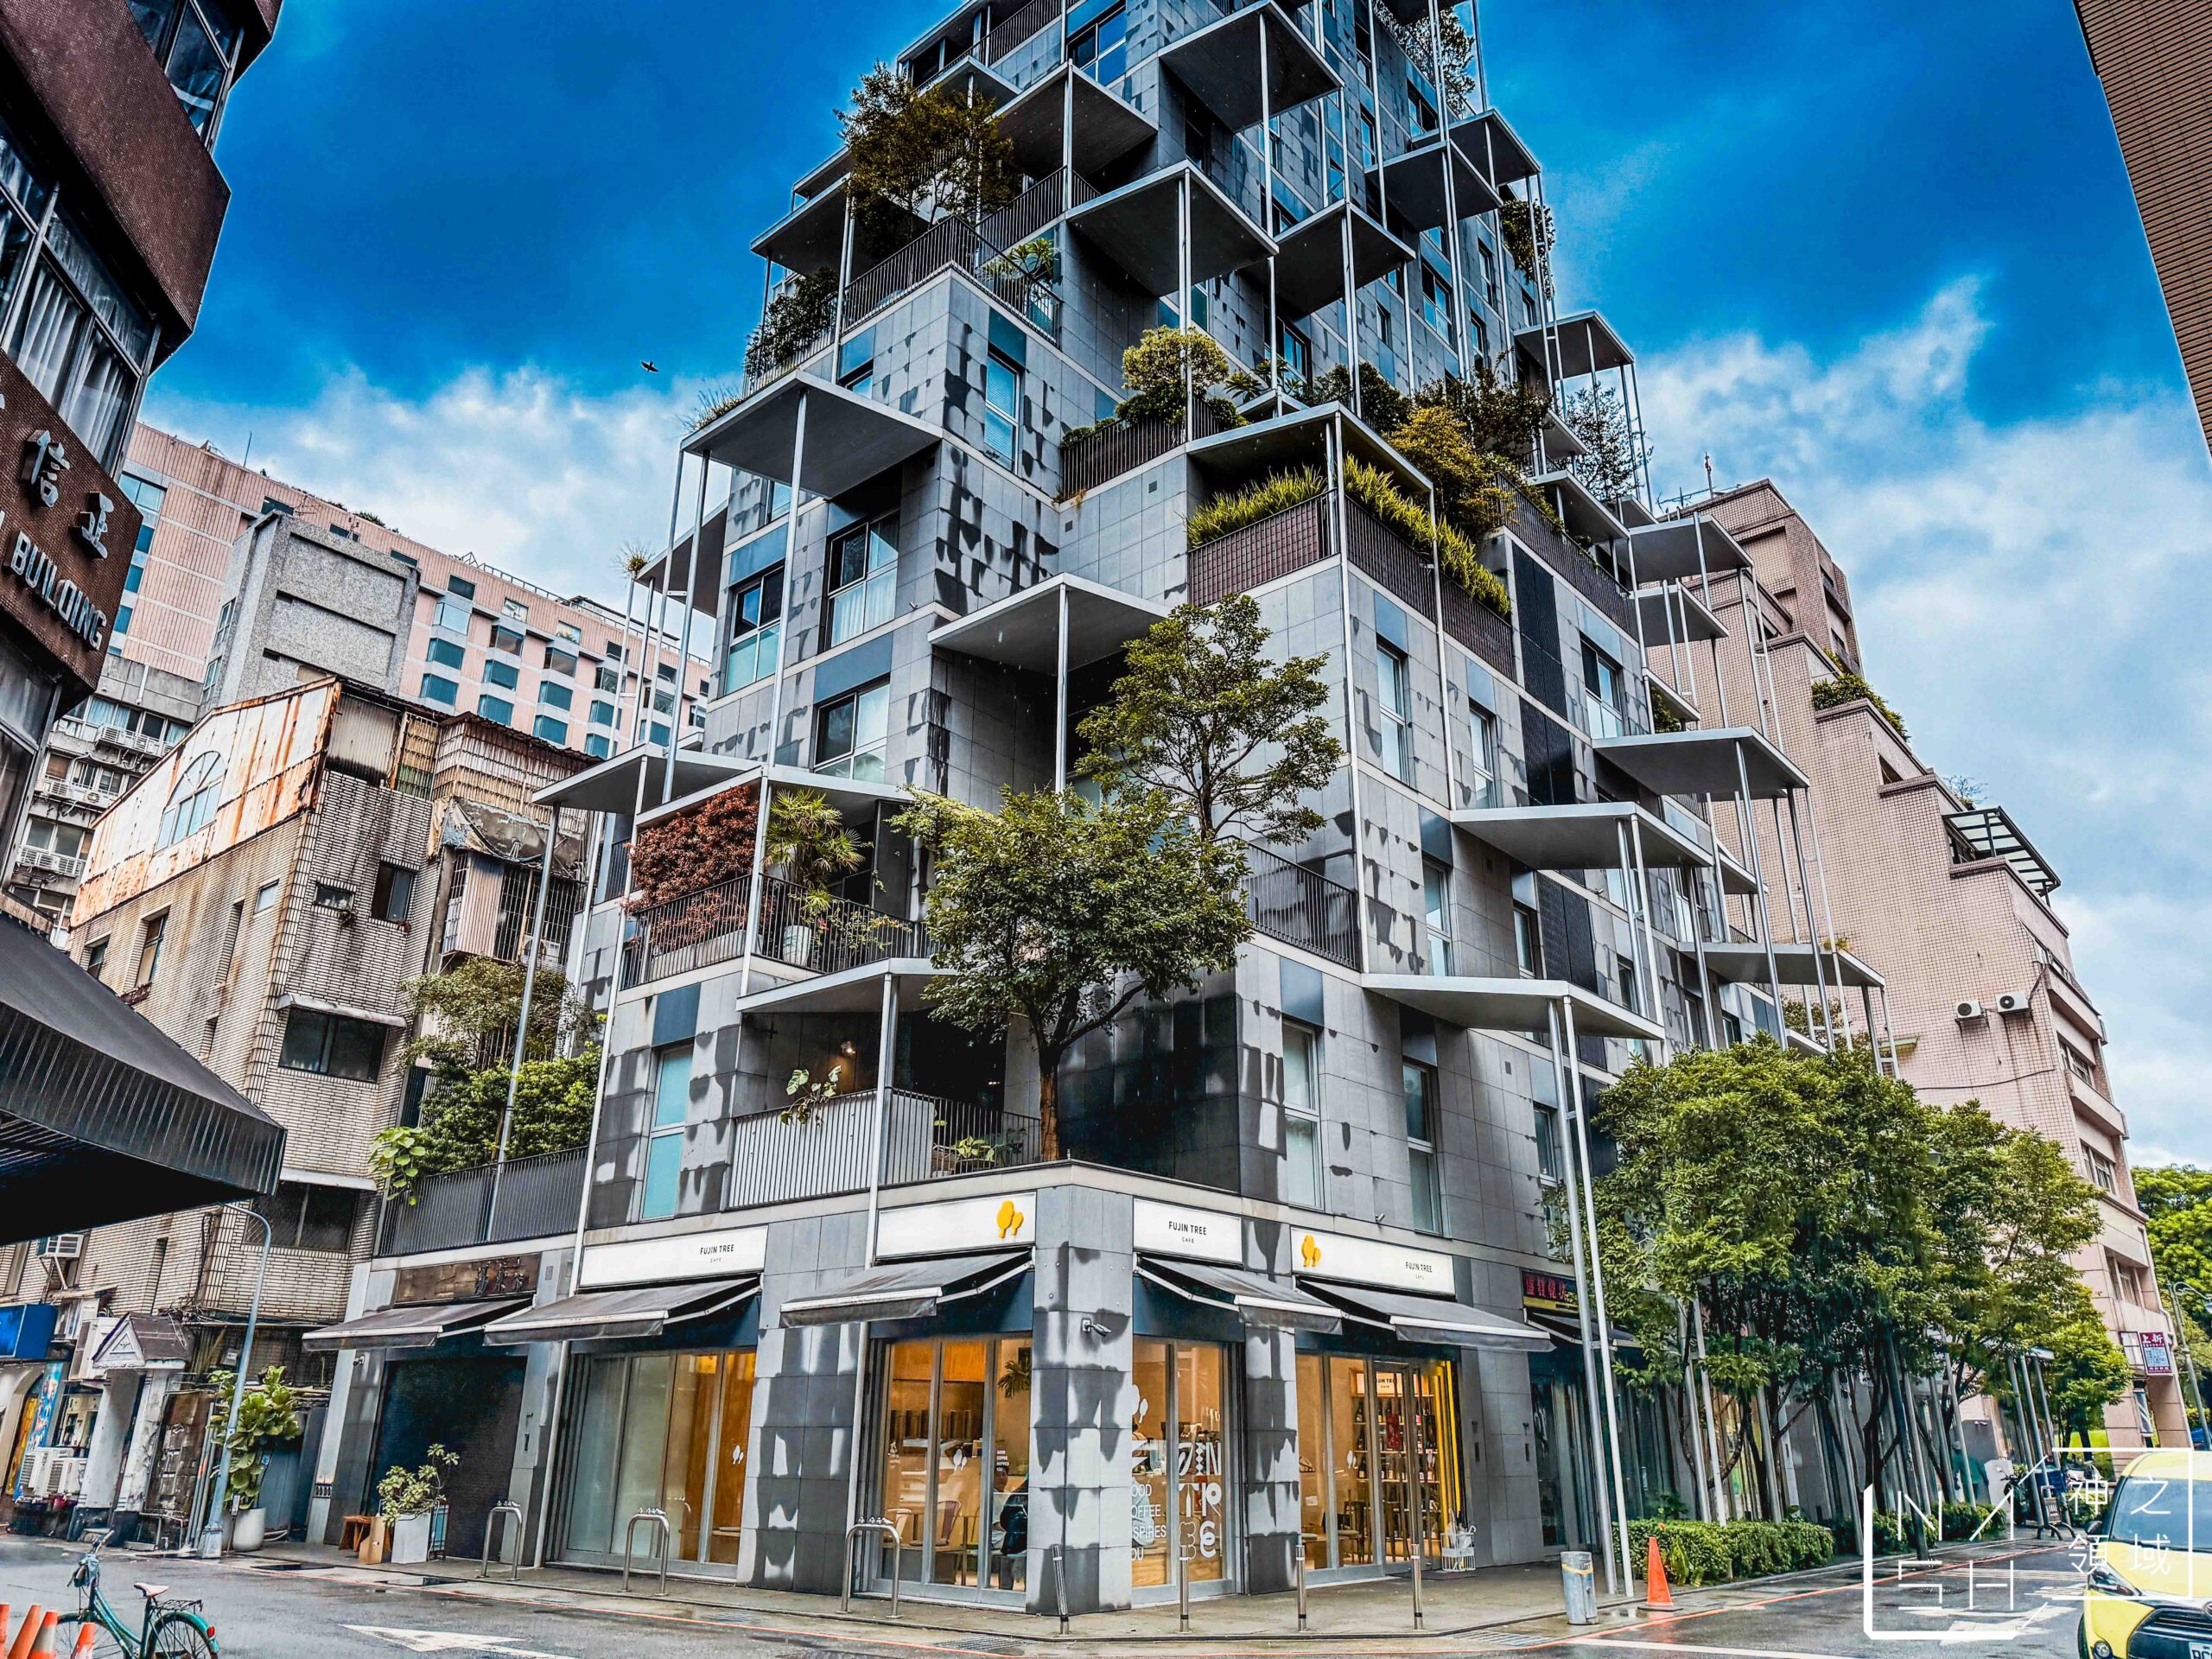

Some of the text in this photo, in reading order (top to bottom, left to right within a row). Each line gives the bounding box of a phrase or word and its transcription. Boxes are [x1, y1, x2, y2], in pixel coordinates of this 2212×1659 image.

[10, 531, 108, 652] BUILDING
[1168, 1221, 1207, 1236] FUJIN TREE
[700, 1244, 734, 1255] FUJIN TREE
[1421, 1264, 1433, 1273] TREE
[1132, 1484, 1152, 1497] OOD
[1131, 1504, 1161, 1518] OFFEE
[1133, 1524, 1166, 1539] SPIRES
[1131, 1548, 1144, 1561] OU
